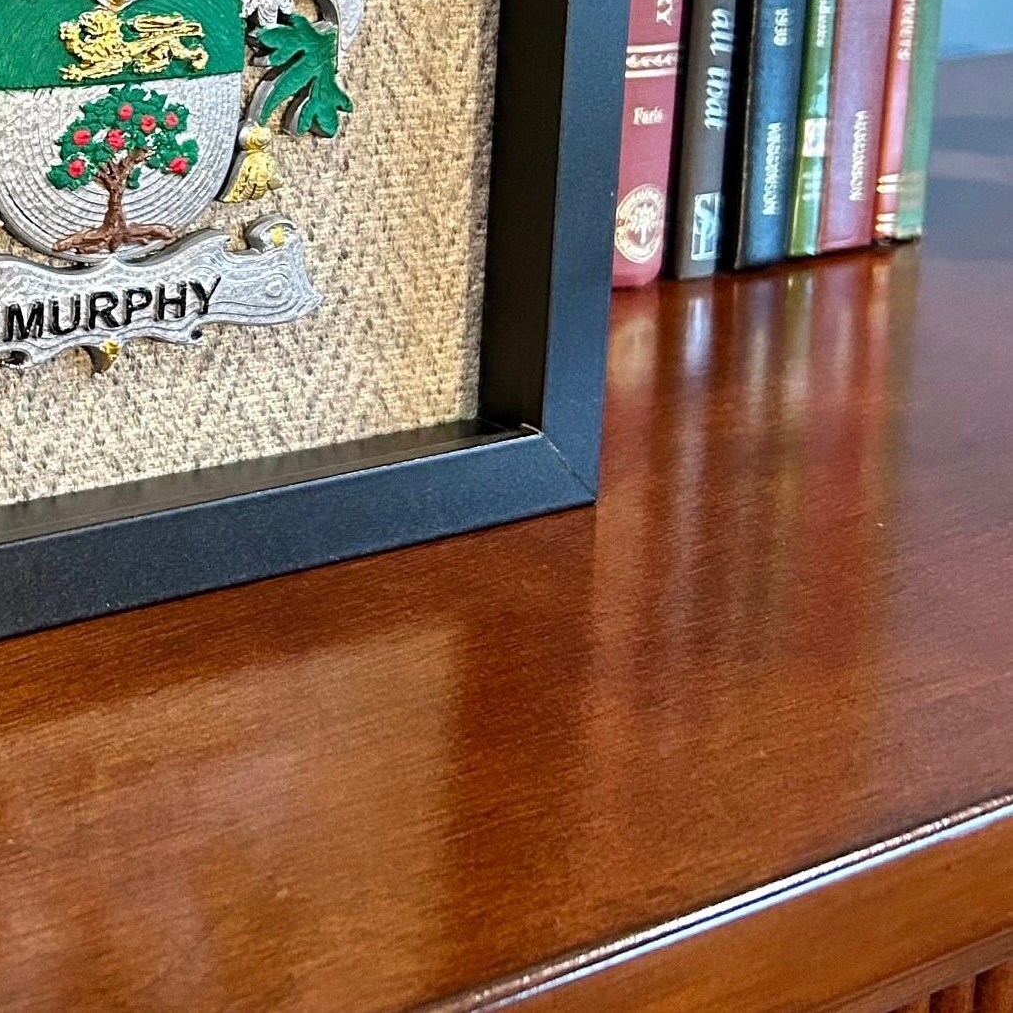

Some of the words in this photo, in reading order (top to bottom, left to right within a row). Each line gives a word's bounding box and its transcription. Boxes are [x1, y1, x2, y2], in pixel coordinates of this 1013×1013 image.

[709, 8, 735, 56] all
[703, 67, 731, 132] that
[2, 274, 222, 344] MURPHY
